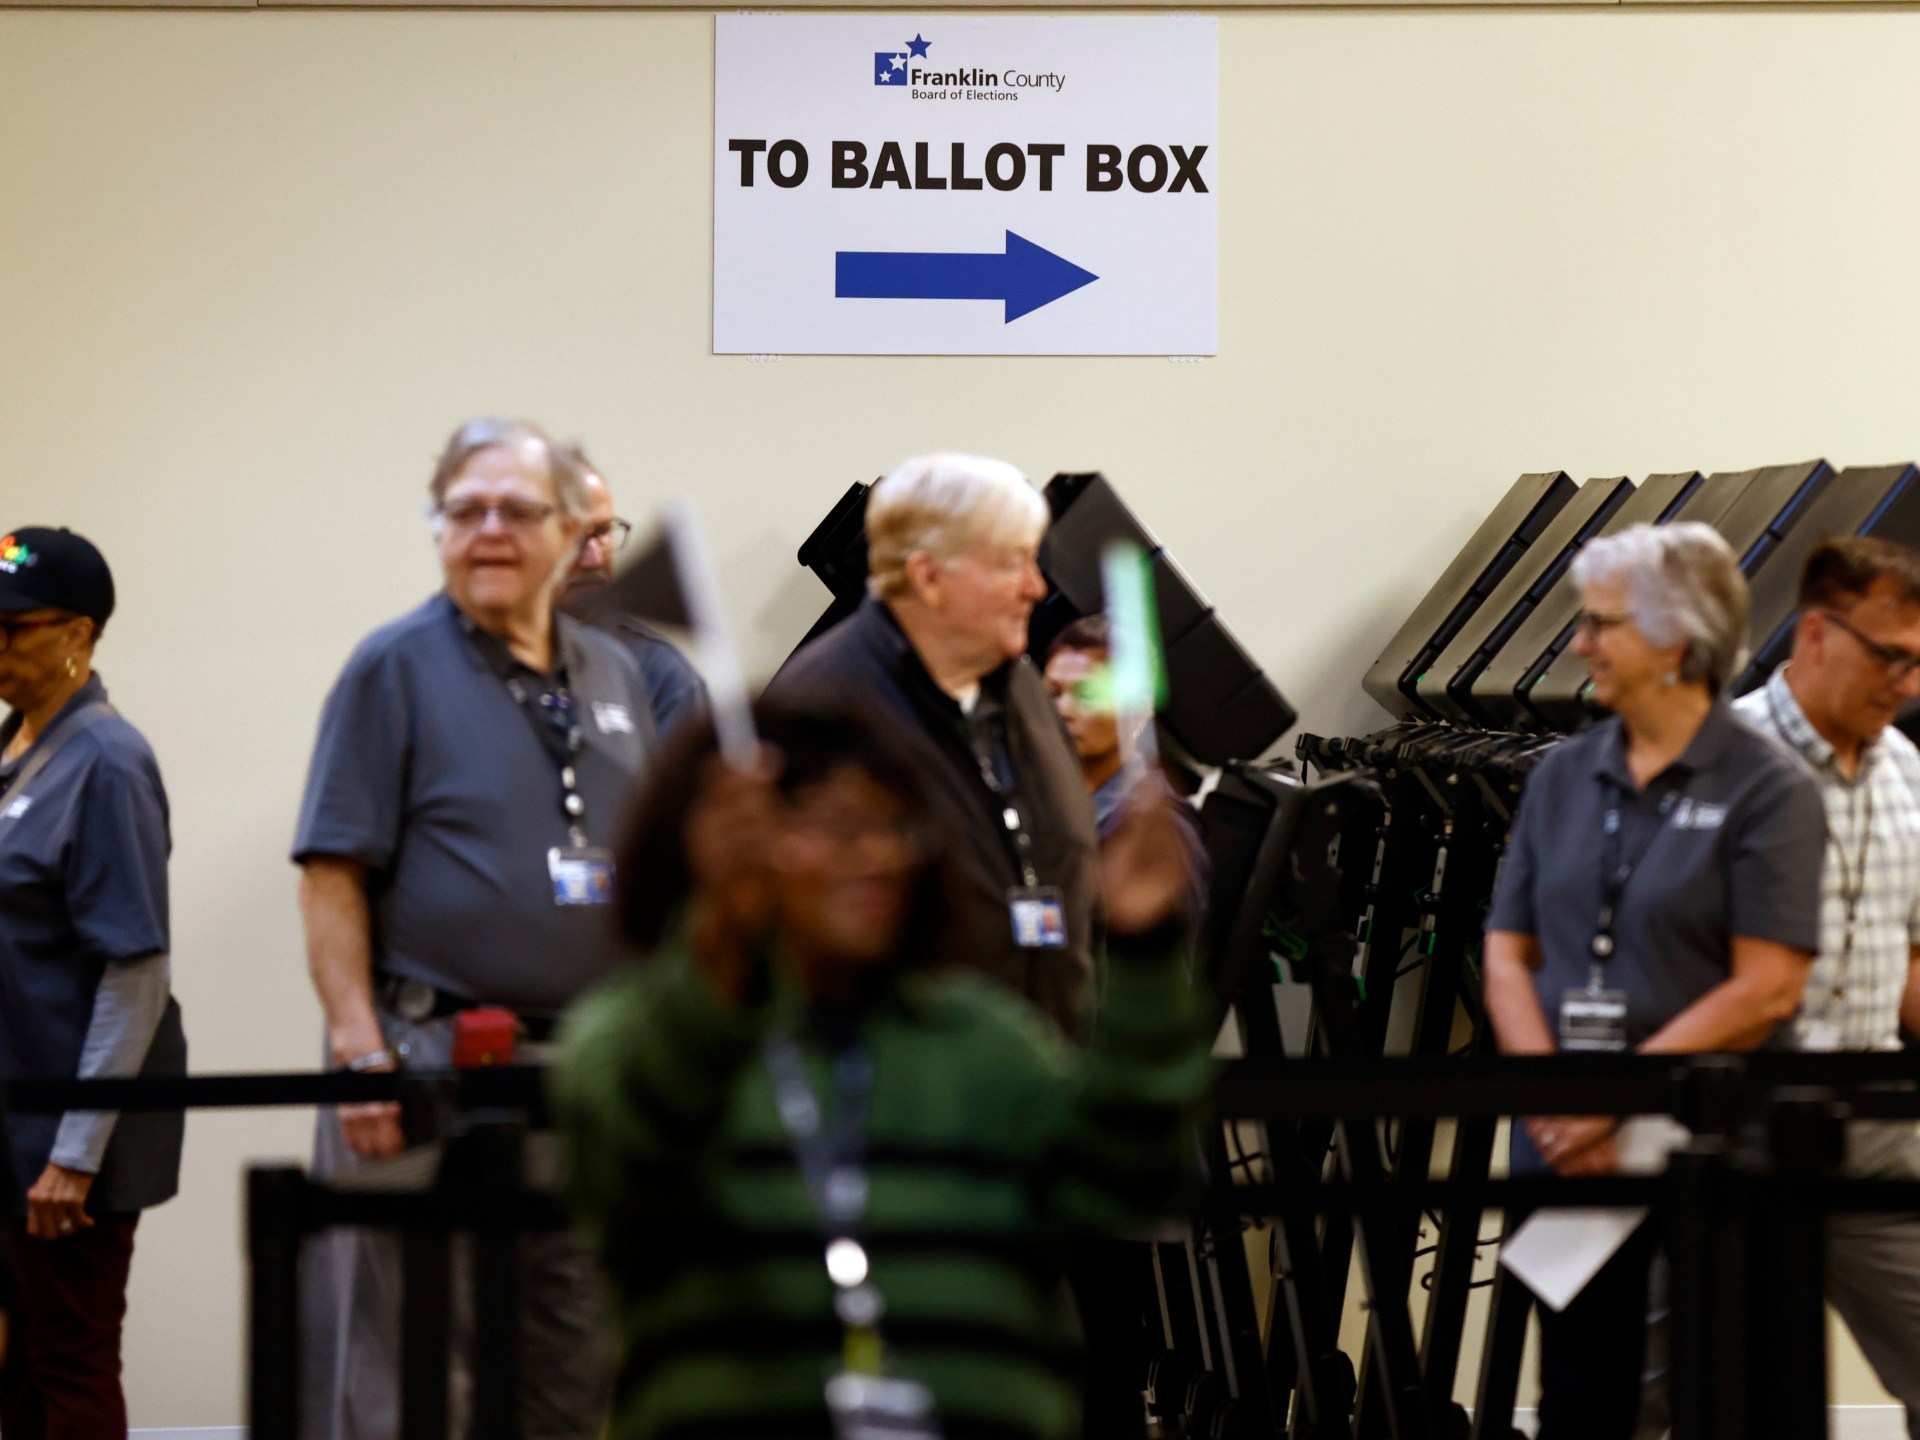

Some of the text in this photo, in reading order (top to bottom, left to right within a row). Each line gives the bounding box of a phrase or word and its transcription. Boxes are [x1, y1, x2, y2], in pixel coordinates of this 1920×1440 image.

[911, 68, 1066, 93] Franklin County
[912, 89, 1018, 101] Board of Elections
[728, 138, 1209, 193] TO BALLOT BOX
